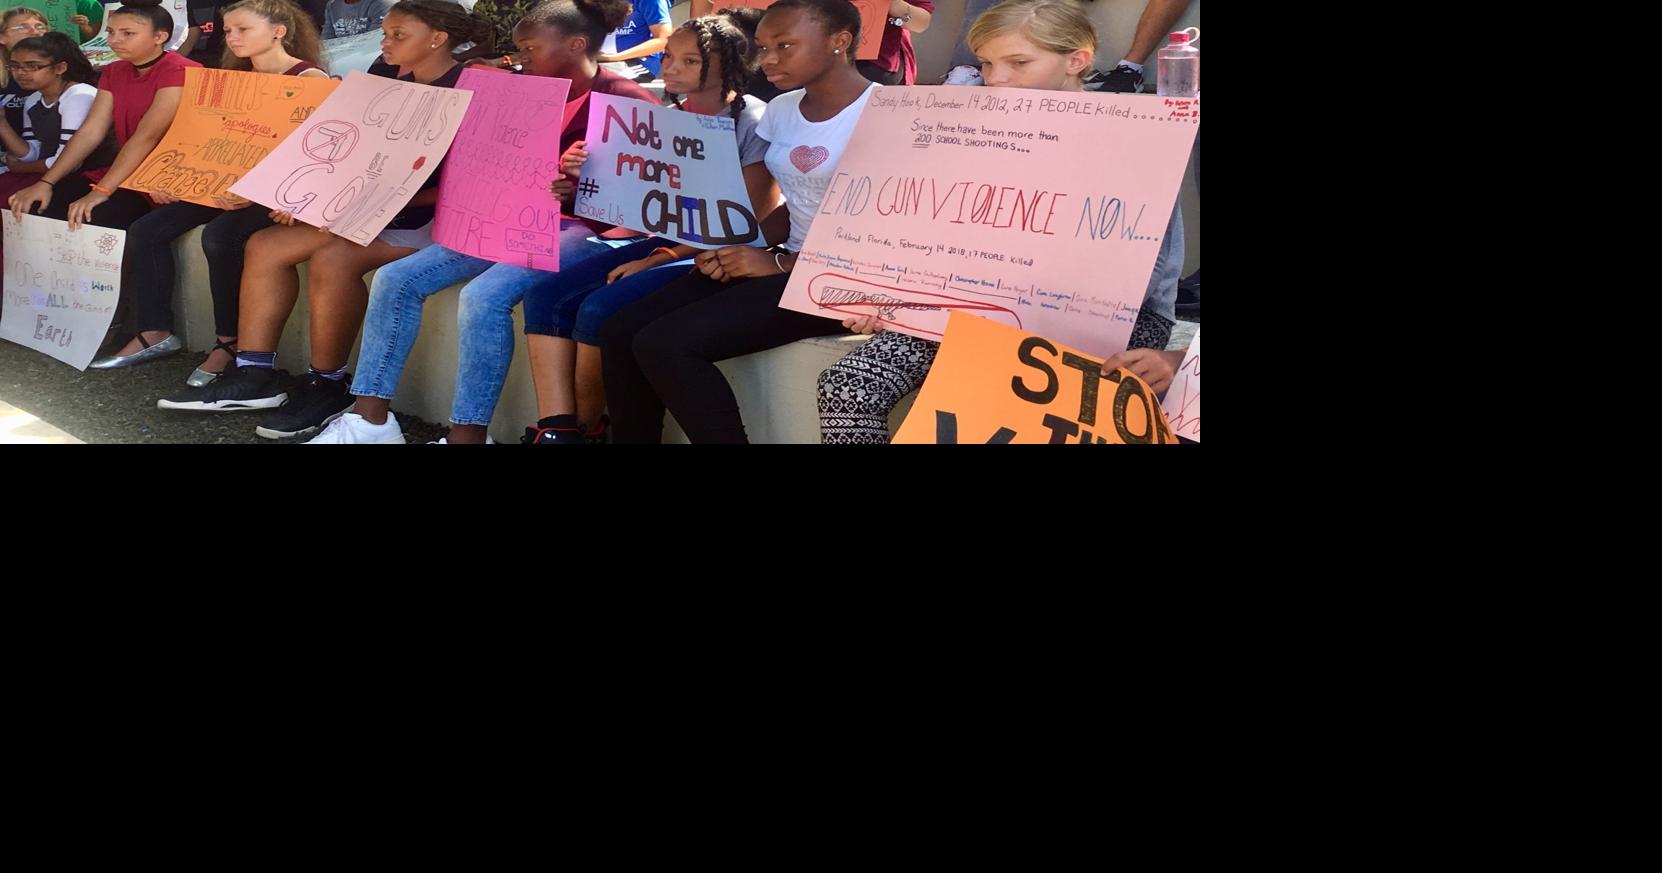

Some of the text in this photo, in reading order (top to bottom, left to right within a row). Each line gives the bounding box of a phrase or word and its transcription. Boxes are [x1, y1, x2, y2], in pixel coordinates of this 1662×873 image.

[363, 83, 460, 146] GUNS
[871, 90, 899, 112] Sandy
[925, 93, 964, 110] December
[967, 93, 980, 109] 14
[981, 95, 1009, 114] 2012,
[1013, 97, 1033, 113] 27
[1039, 98, 1093, 115] PEOPLE
[602, 104, 662, 150] Not
[673, 136, 705, 160] one
[911, 118, 1059, 142] Since there have been more than
[914, 133, 932, 144] 200
[935, 134, 962, 146] SCHOOL
[616, 152, 681, 189] more
[578, 197, 625, 226] Save Us
[641, 189, 759, 245] CHILD
[821, 172, 871, 216] END
[876, 176, 924, 216] GUN
[931, 178, 1067, 236] VIOLENCE
[899, 238, 933, 256] February
[936, 244, 945, 252] 14
[980, 250, 1005, 262] PEOPLE
[45, 292, 69, 309] ALL
